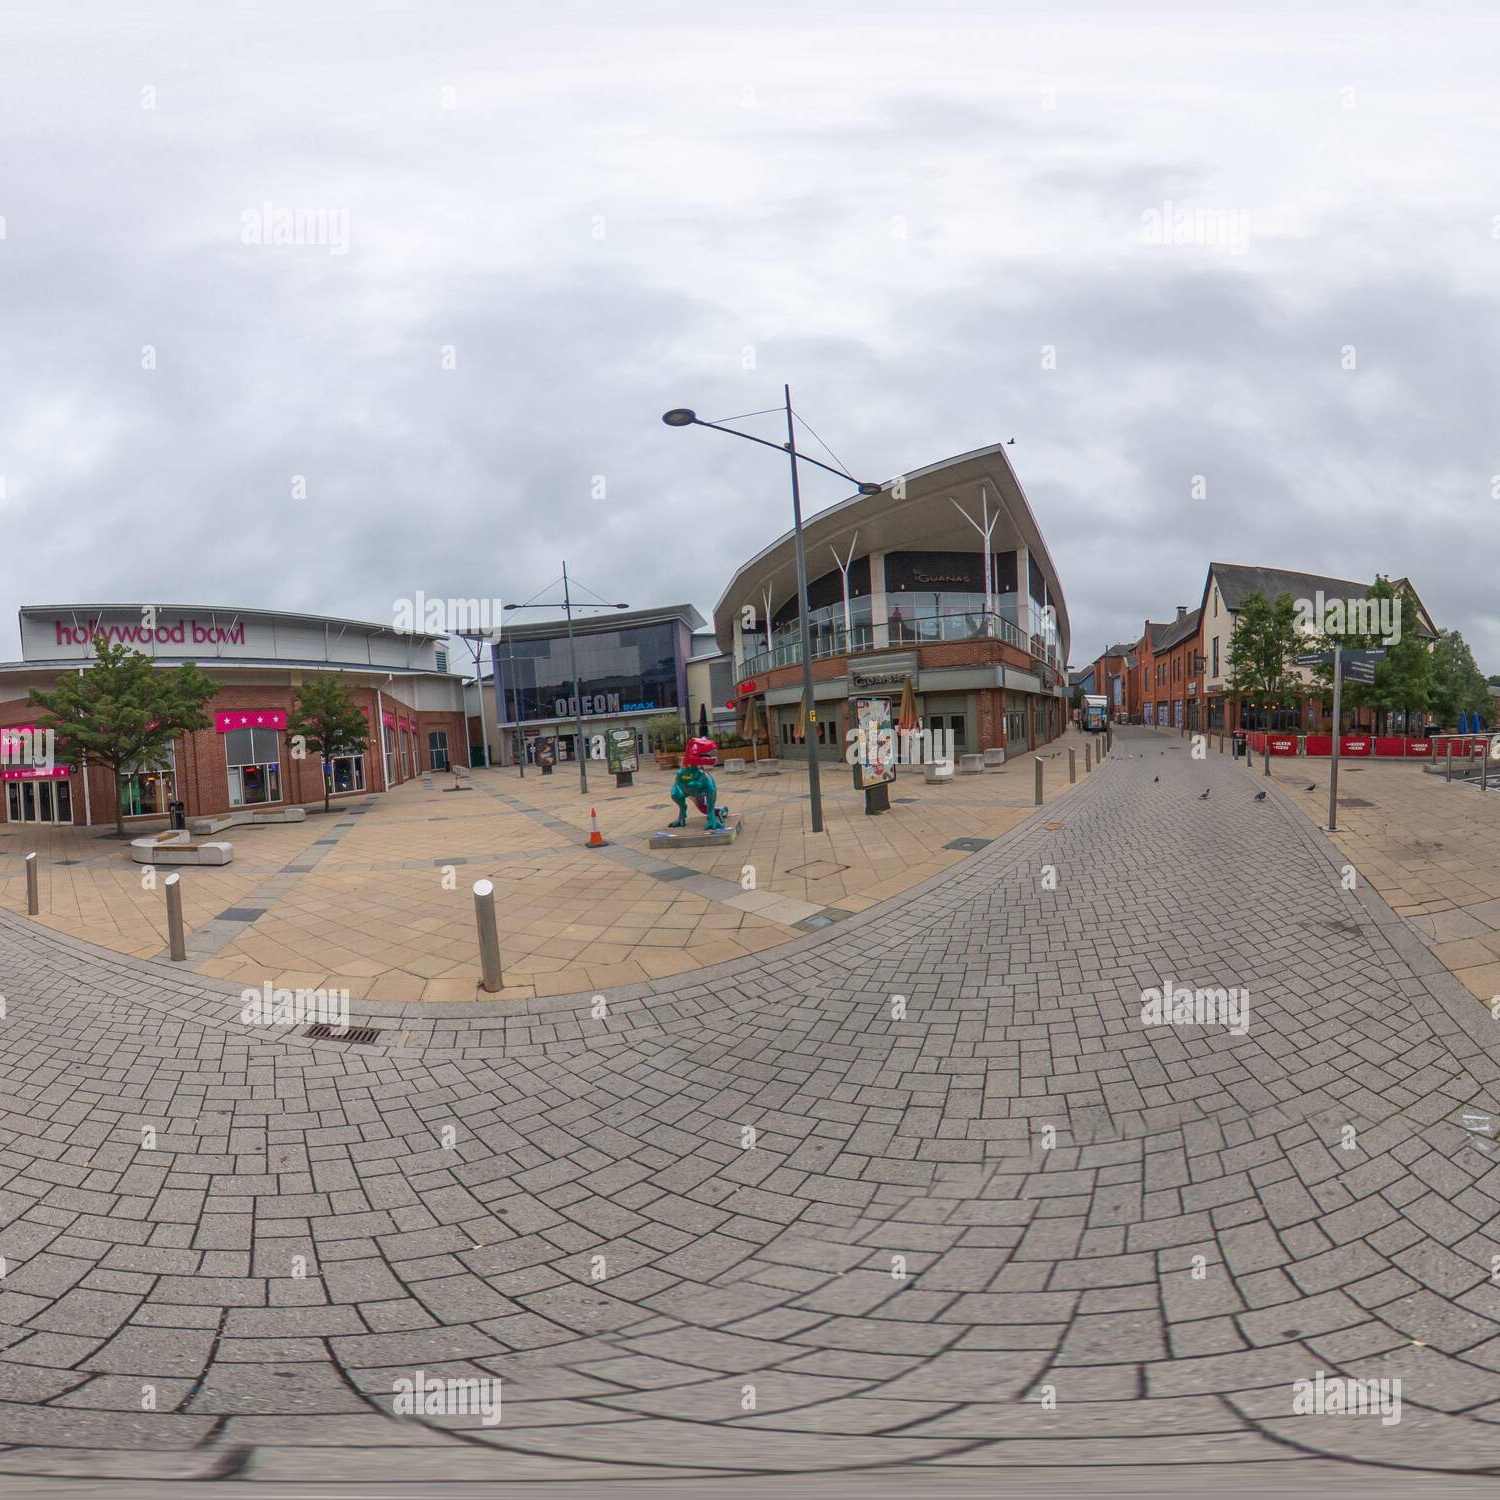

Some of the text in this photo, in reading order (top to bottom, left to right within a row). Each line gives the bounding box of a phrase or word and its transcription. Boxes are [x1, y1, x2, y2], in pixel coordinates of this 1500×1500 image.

[56, 619, 245, 645] hollywood bowl
[555, 693, 655, 717] ODEON IMAX
